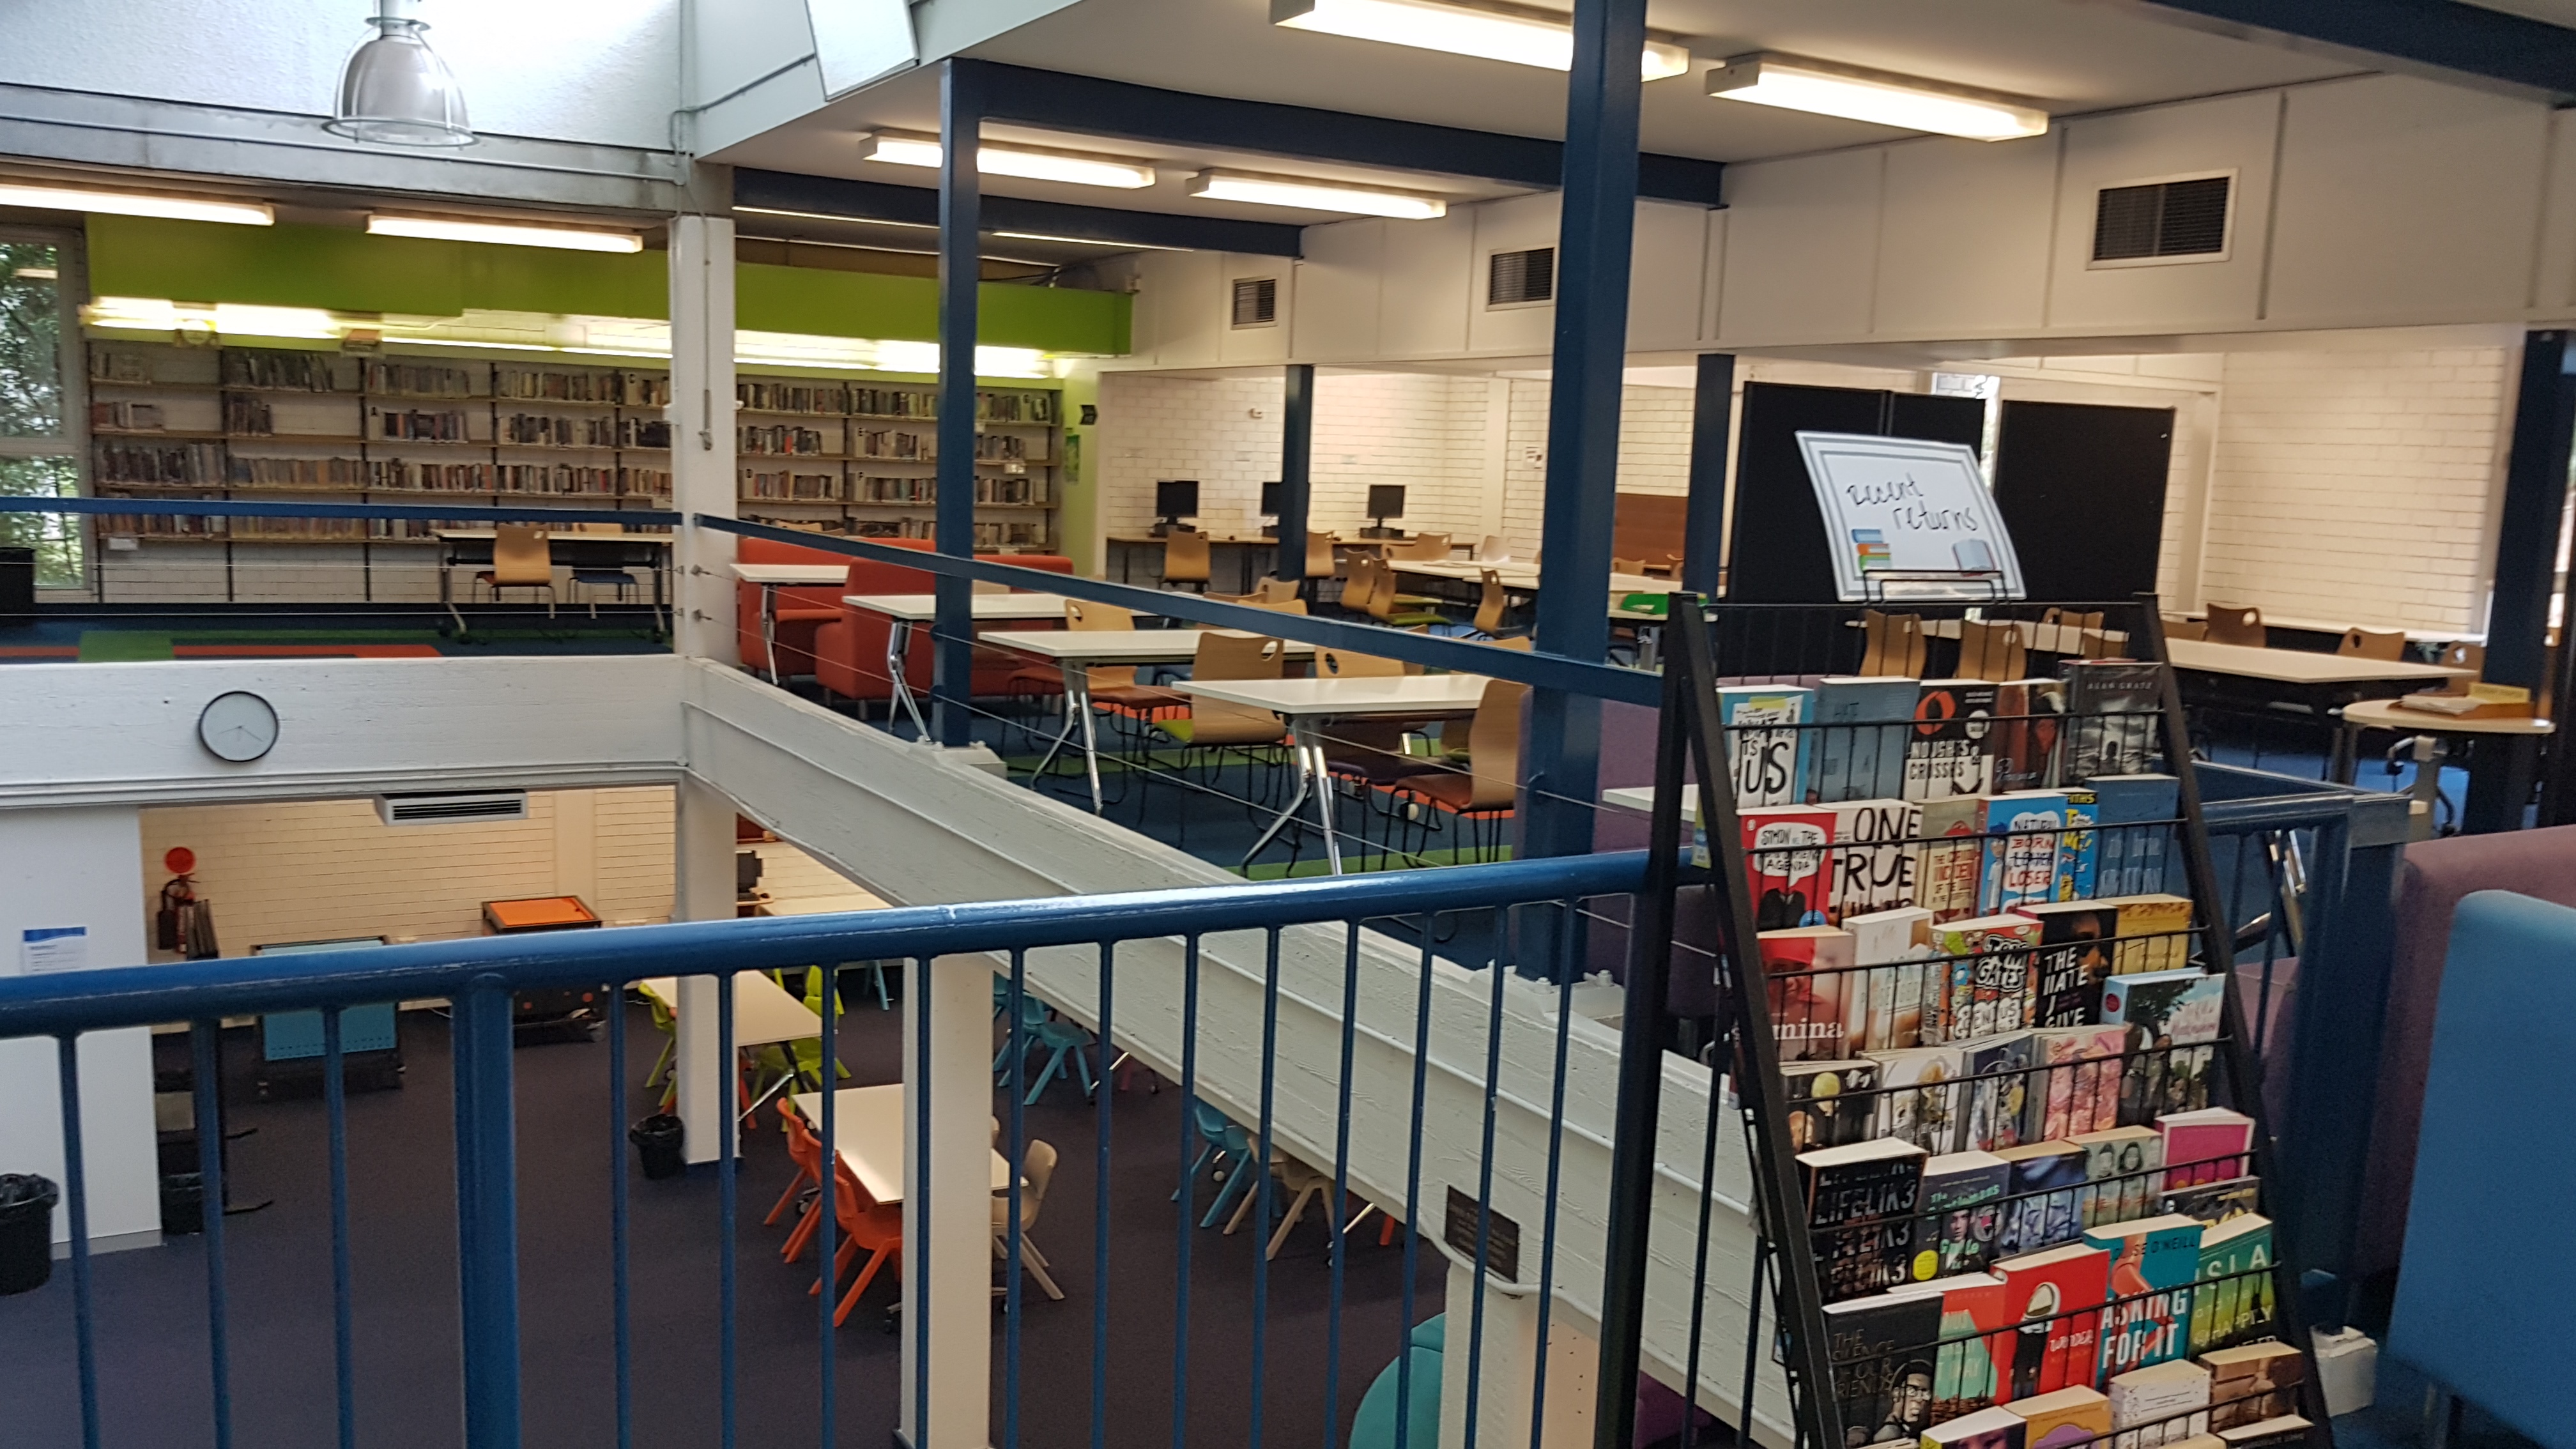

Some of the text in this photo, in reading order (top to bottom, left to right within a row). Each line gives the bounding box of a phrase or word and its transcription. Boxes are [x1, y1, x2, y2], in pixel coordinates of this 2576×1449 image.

[1891, 500, 1979, 532] returns
[1745, 742, 1790, 794] US
[1854, 808, 1923, 842] ONE
[1832, 852, 1916, 893] TRUE
[2044, 946, 2078, 974] THE
[2044, 1007, 2085, 1028] GIVE
[2154, 1322, 2179, 1358] IT
